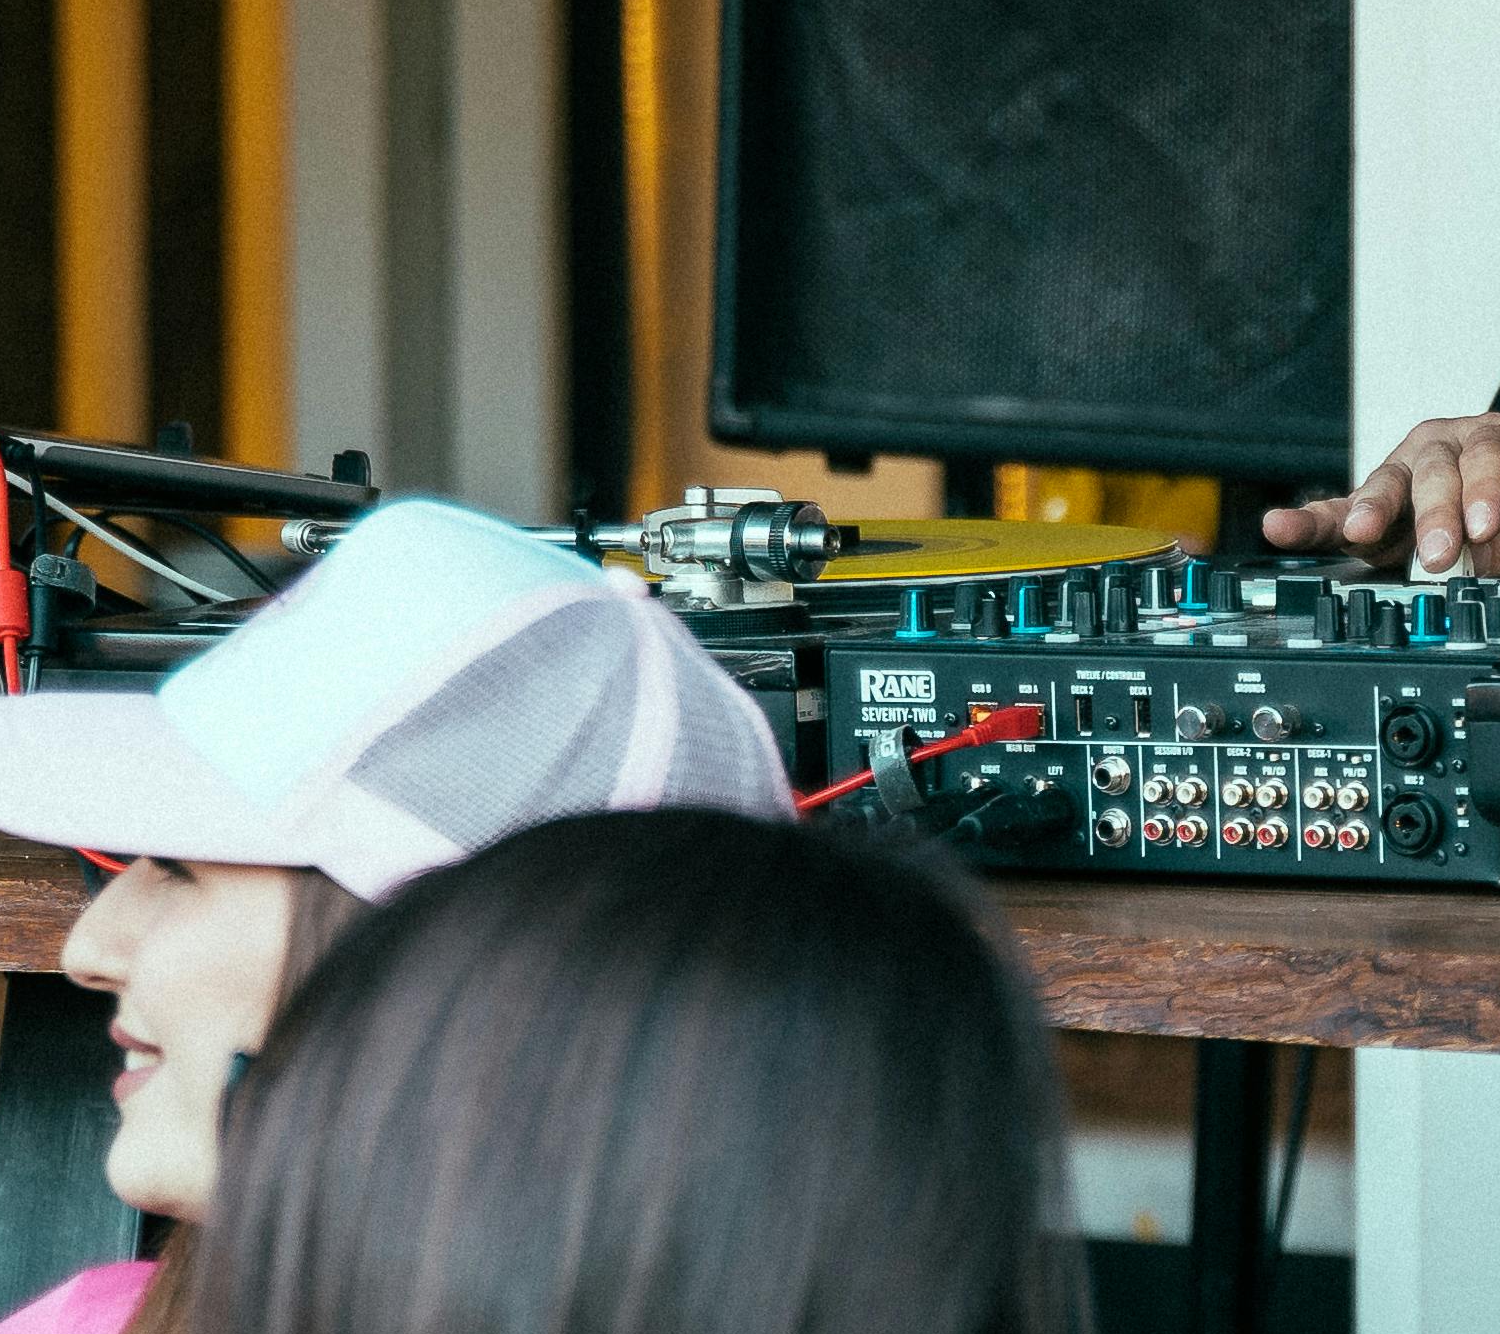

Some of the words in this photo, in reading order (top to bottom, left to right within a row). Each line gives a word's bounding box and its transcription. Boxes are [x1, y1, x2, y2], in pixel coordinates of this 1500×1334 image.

[859, 669, 933, 703] RANE
[861, 706, 937, 723] SEVENTY-TWO
[1047, 765, 1064, 776] LEFT
